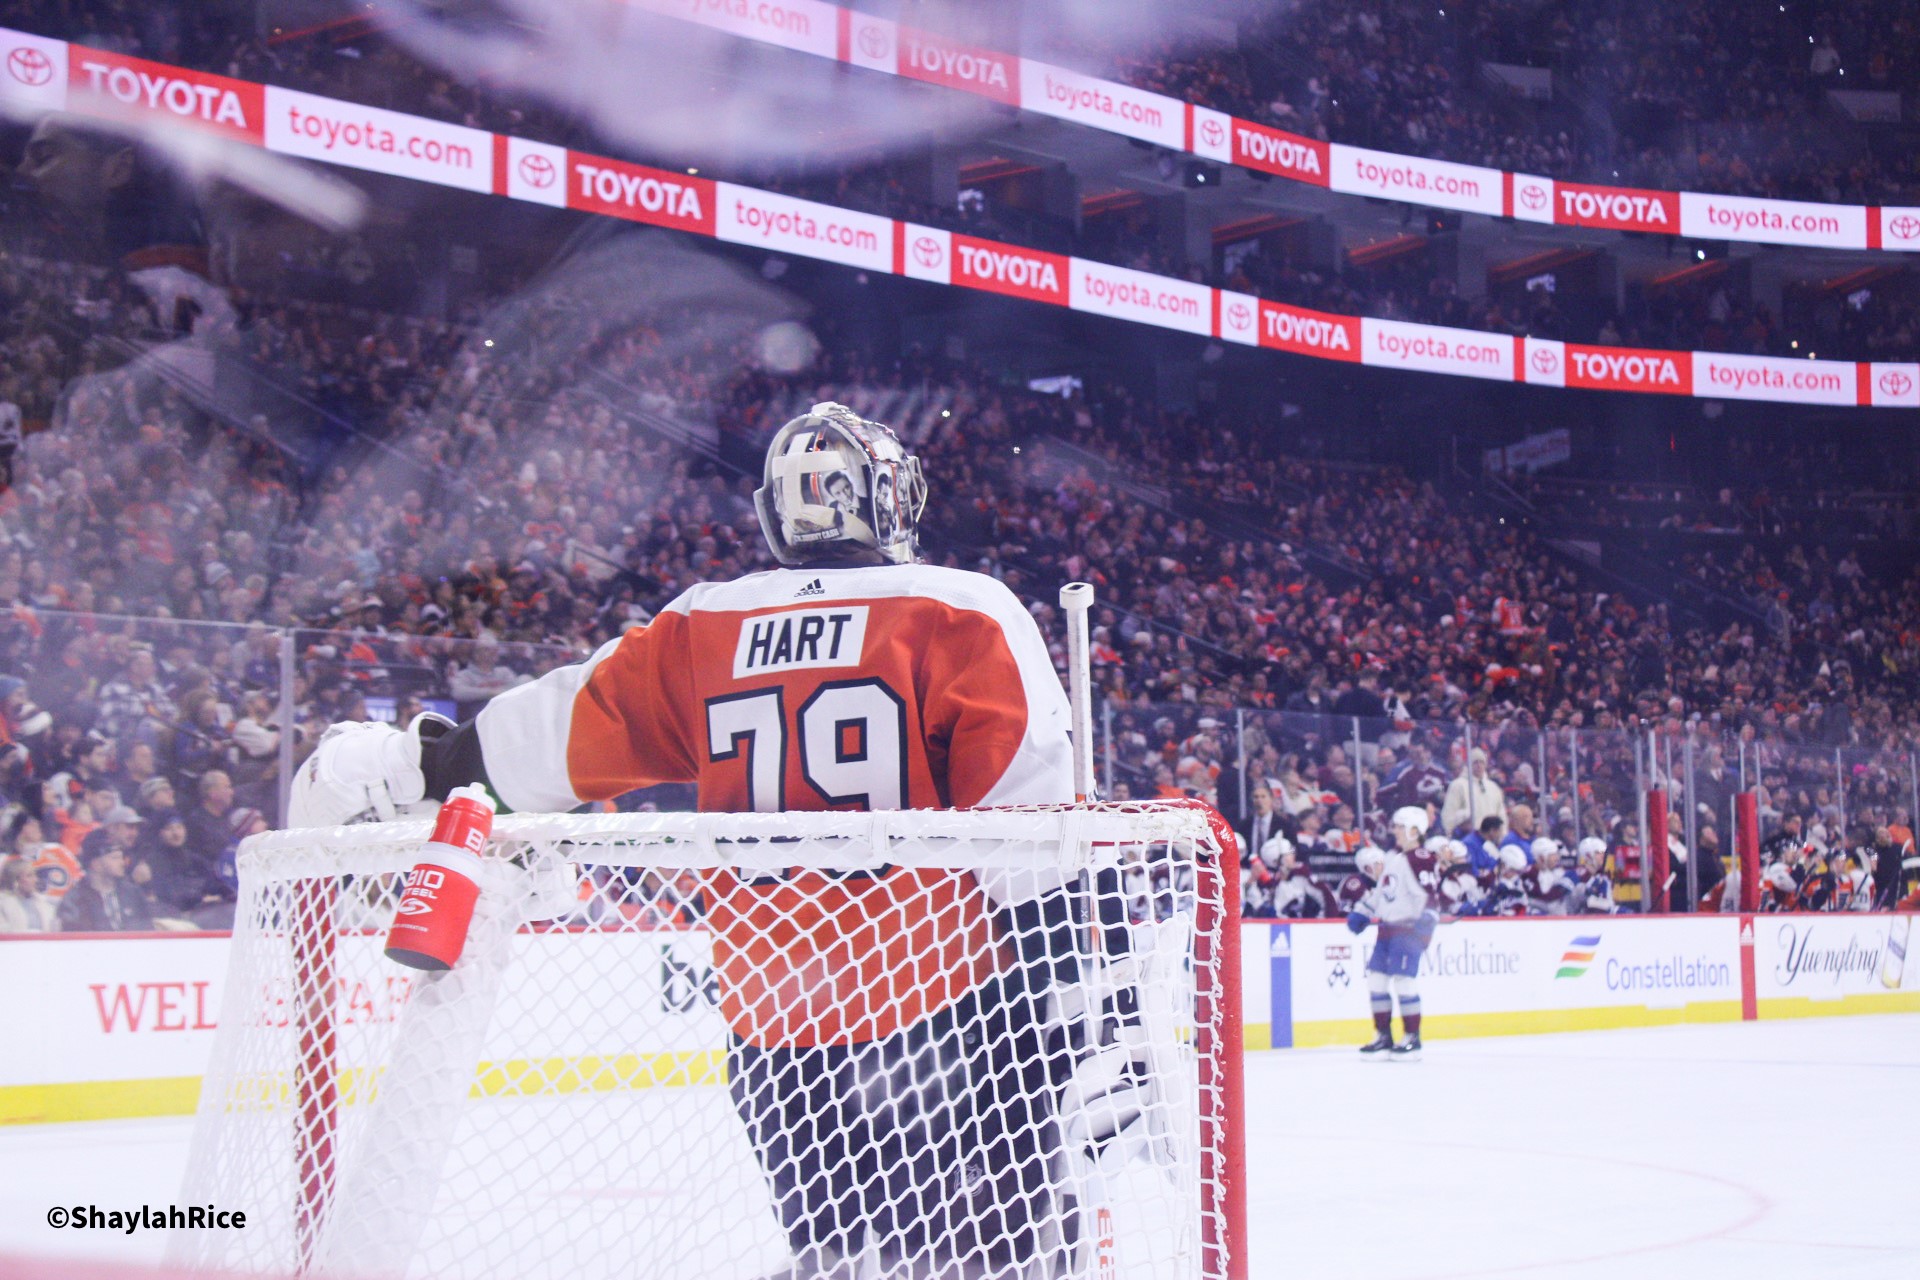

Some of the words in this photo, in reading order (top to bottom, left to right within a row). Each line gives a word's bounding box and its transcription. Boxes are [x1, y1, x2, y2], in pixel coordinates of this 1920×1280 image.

[908, 42, 1008, 90] TOYOTA
[82, 61, 247, 129] TOYOTA
[1045, 75, 1163, 129] toyota.com
[288, 106, 473, 169] toyota.com
[1237, 128, 1321, 175] TOYOTA
[576, 164, 703, 220] TOYOTA
[1355, 158, 1480, 199] toyota.com
[735, 199, 878, 252] toyota.com
[1560, 190, 1668, 225] TOYOTA
[1707, 204, 1839, 236] toyota.com
[958, 245, 1059, 293] TOYOTA
[1084, 273, 1200, 317] toyota.com
[1263, 309, 1350, 350] TOYOTA
[1377, 330, 1501, 366] toyota.com
[1572, 352, 1680, 385] TOYOTA
[1708, 362, 1842, 394] toyota.com
[746, 613, 852, 669] HART
[704, 676, 910, 813] 79
[406, 869, 446, 890] BIO
[1420, 939, 1521, 978] Medicine
[1605, 956, 1730, 992] Constellation
[1776, 922, 1880, 987] Yuengling
